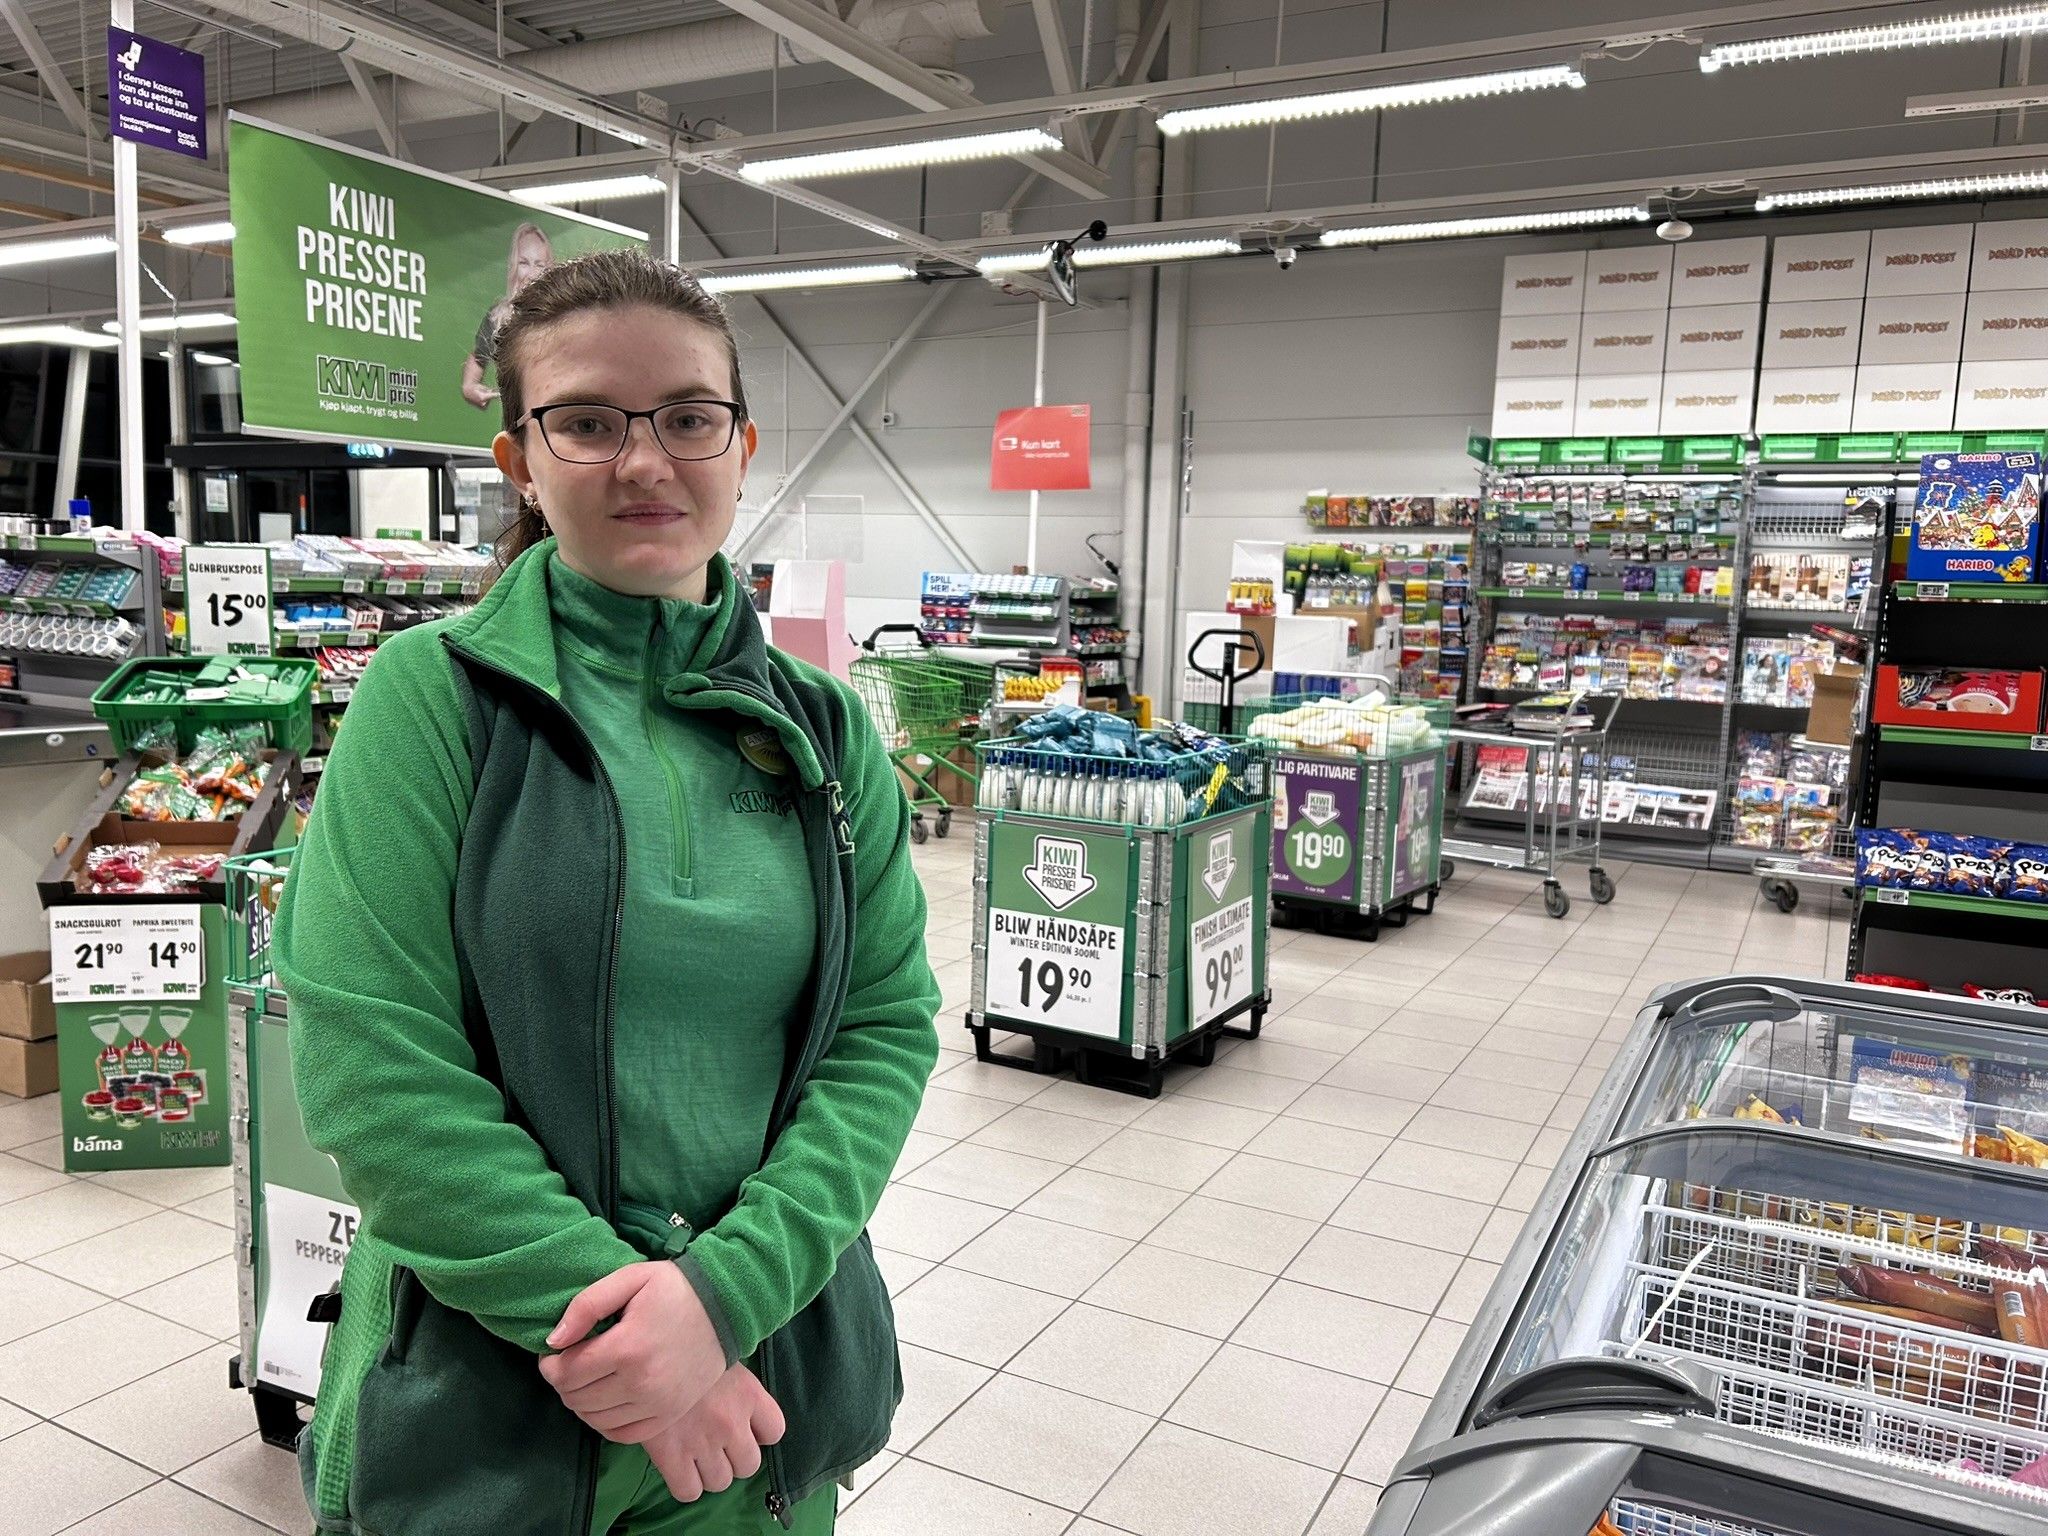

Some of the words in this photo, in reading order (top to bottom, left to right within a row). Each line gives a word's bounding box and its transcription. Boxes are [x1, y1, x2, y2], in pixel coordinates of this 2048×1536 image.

[119, 81, 136, 94] kan
[137, 86, 150, 98] du
[151, 92, 174, 105] sette
[175, 98, 188, 109] inn
[123, 72, 152, 88] denne
[153, 81, 184, 97] kassen
[119, 94, 131, 105] og
[132, 96, 143, 106] ta
[145, 100, 155, 110] ut
[155, 104, 198, 122] kontanter
[329, 182, 396, 240] KIWI
[297, 226, 427, 295] PRESSER
[305, 279, 424, 342] PRISENE
[317, 355, 387, 402] KIWI
[389, 369, 417, 387] mini
[390, 387, 416, 406] pris
[320, 400, 340, 412] Kjøp
[341, 402, 365, 415] kjapt,
[366, 405, 386, 417] trygt
[387, 409, 398, 419] og
[399, 409, 418, 422] billig
[1021, 440, 1040, 449] Kun
[1041, 440, 1061, 449] kort
[1958, 454, 2001, 462] HARIBO
[189, 563, 263, 575] GJENBRUKSPOSE
[1947, 560, 1994, 571] HARIBO
[930, 576, 952, 584] SPILL
[227, 642, 256, 654] KIWI
[1276, 760, 1294, 774] LIG
[1297, 762, 1357, 781] PARTIVARE
[1044, 846, 1077, 867] KIWI
[1043, 864, 1076, 880] PRESSER
[55, 919, 122, 929] SNACKSGULROT
[995, 913, 1031, 935] BLIW
[1195, 916, 1218, 944] FINISH
[1219, 902, 1250, 931] ULTIMATE
[1010, 936, 1039, 950] WINTER
[1042, 941, 1072, 955] EDITION
[1074, 947, 1100, 960] 300ML
[90, 983, 114, 995] KIWI
[163, 983, 186, 993] KIWI
[328, 1211, 357, 1247] ZE
